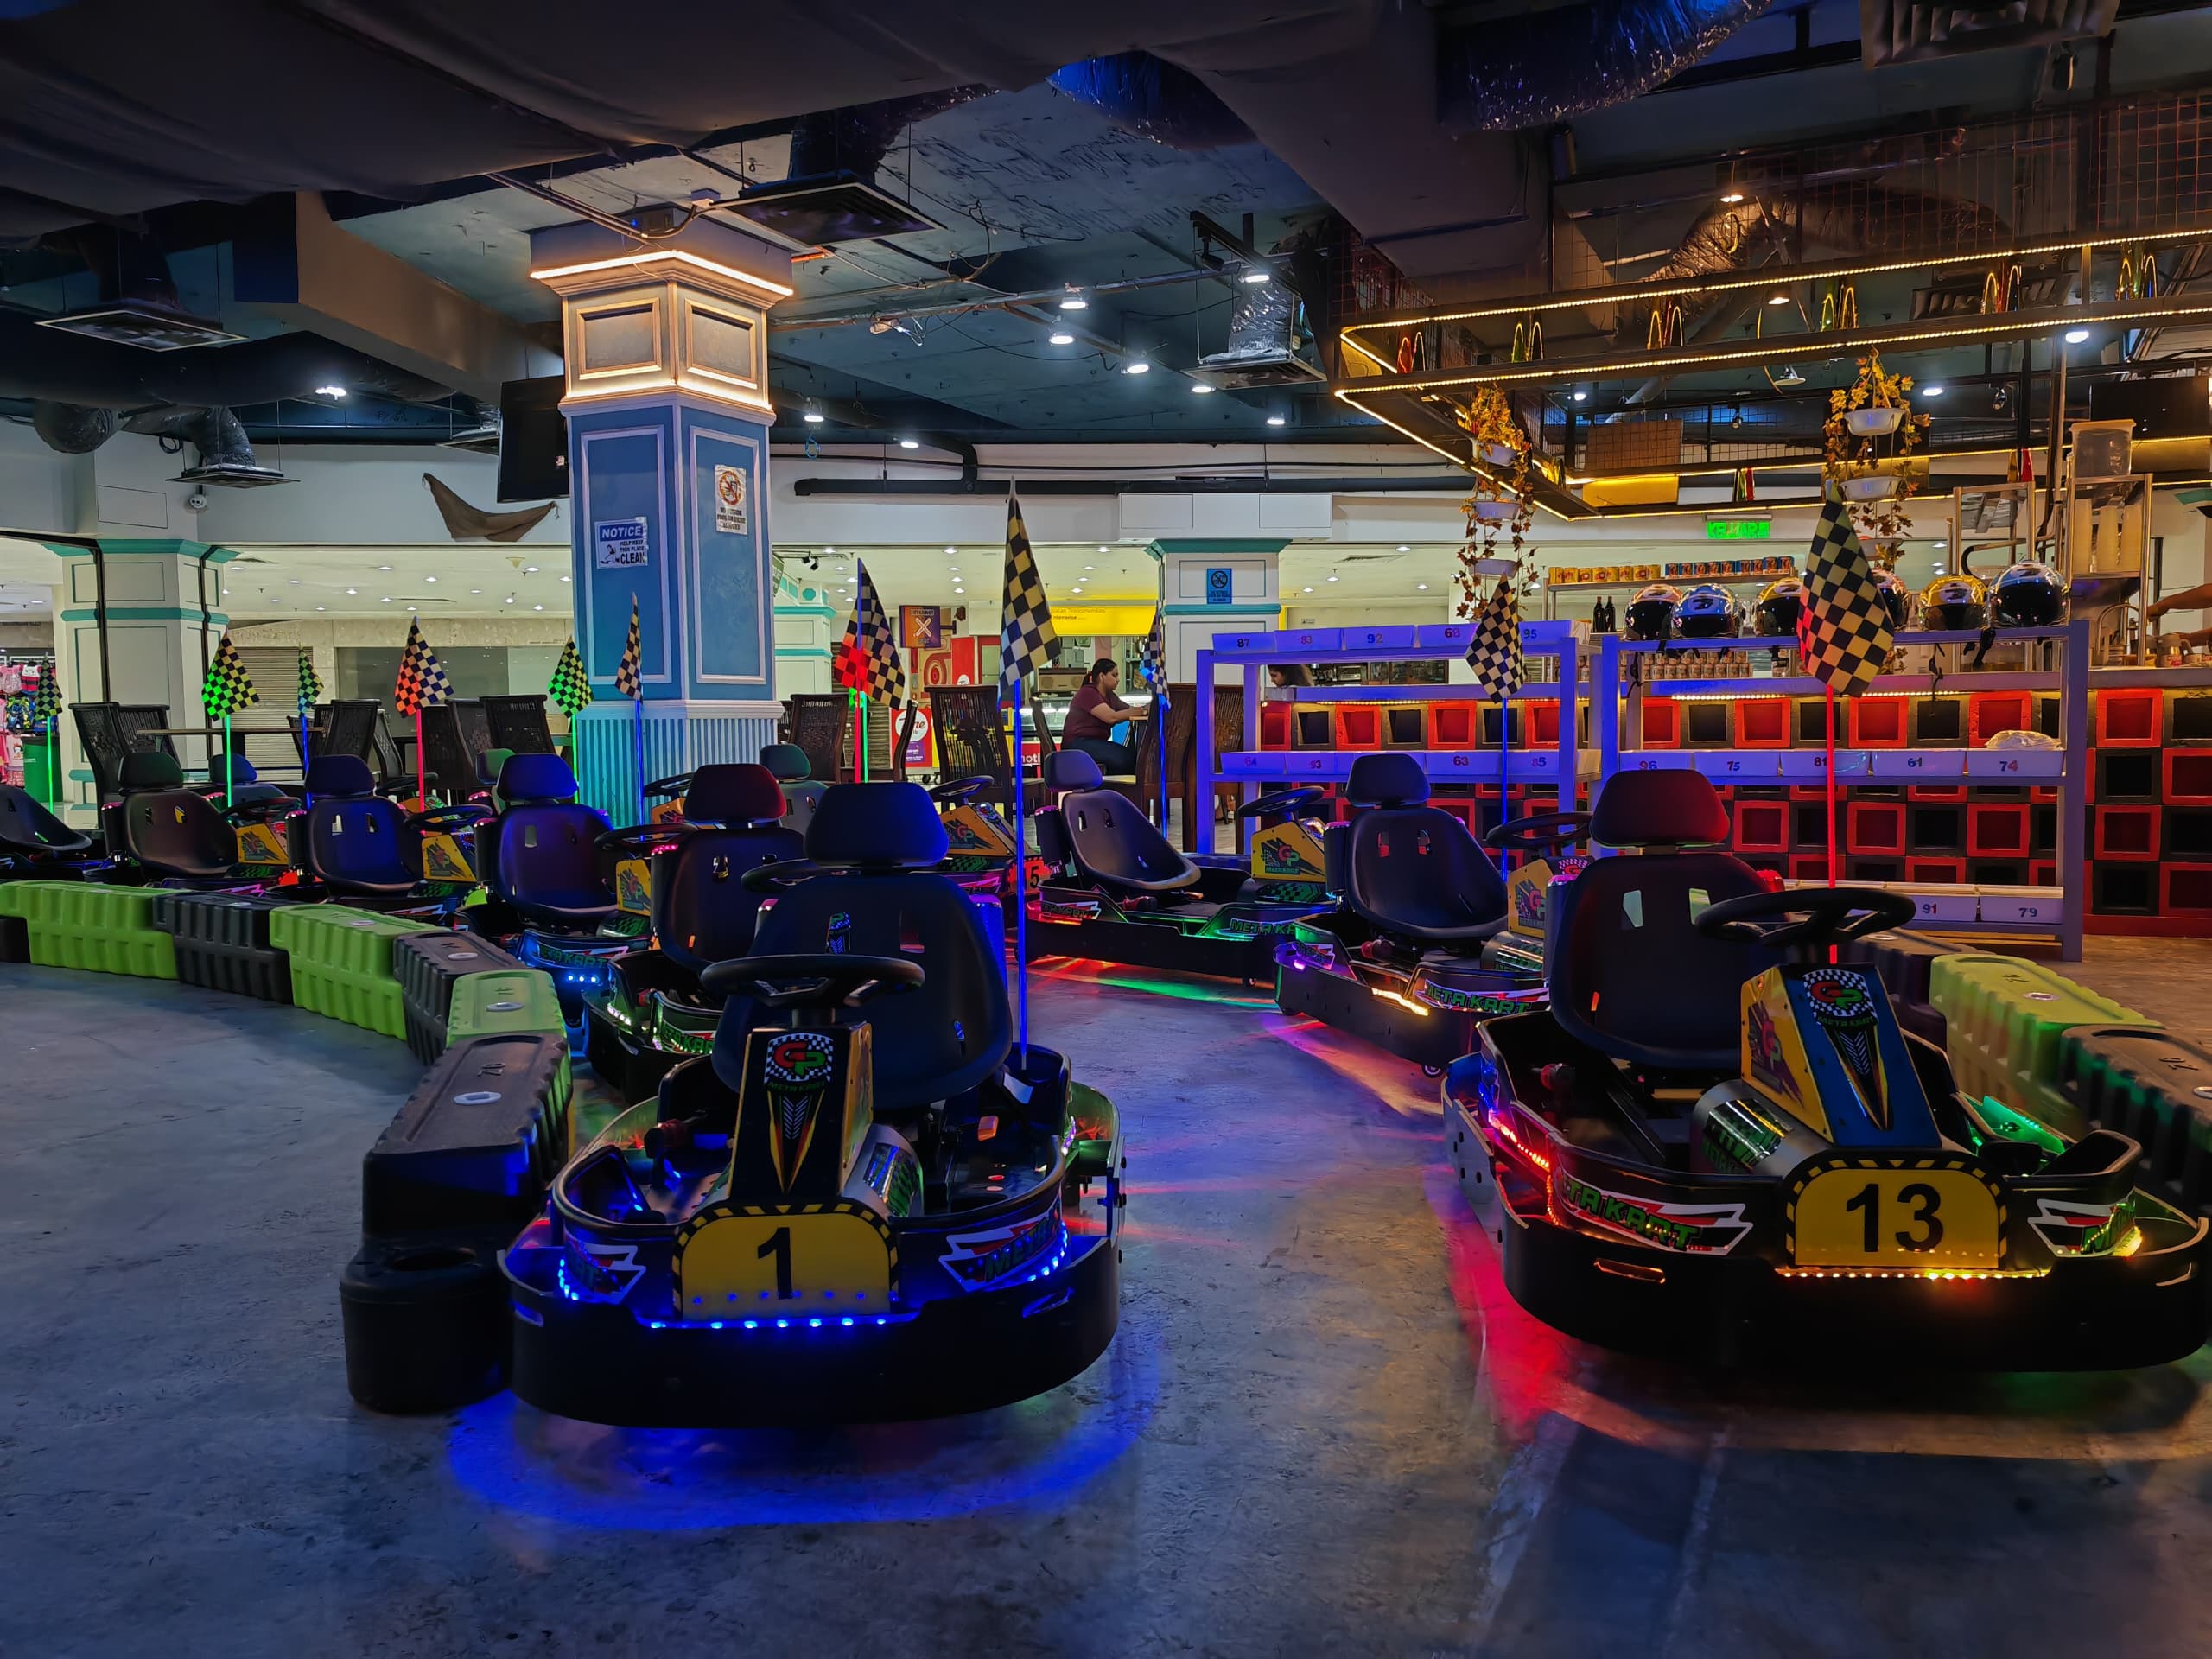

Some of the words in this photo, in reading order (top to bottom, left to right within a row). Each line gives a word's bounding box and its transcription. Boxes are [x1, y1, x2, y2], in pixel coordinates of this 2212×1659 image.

[601, 525, 642, 539] NOTICE
[620, 552, 645, 564] CLEAN
[1367, 633, 1383, 644] 92
[1523, 628, 1537, 639] 95
[1236, 638, 1250, 648] 87
[1453, 755, 1469, 766] 63
[1726, 761, 1740, 772] 75
[1907, 757, 1923, 768] 61
[1999, 760, 2018, 772] 74
[1923, 904, 1937, 914] 91
[2018, 907, 2038, 918] 79
[1810, 981, 1864, 1010] GP
[1469, 994, 1530, 1014] KART
[773, 1041, 827, 1077] GP
[1604, 1197, 1696, 1252] KART
[1846, 1183, 1944, 1254] 13
[757, 1226, 794, 1300] 1
